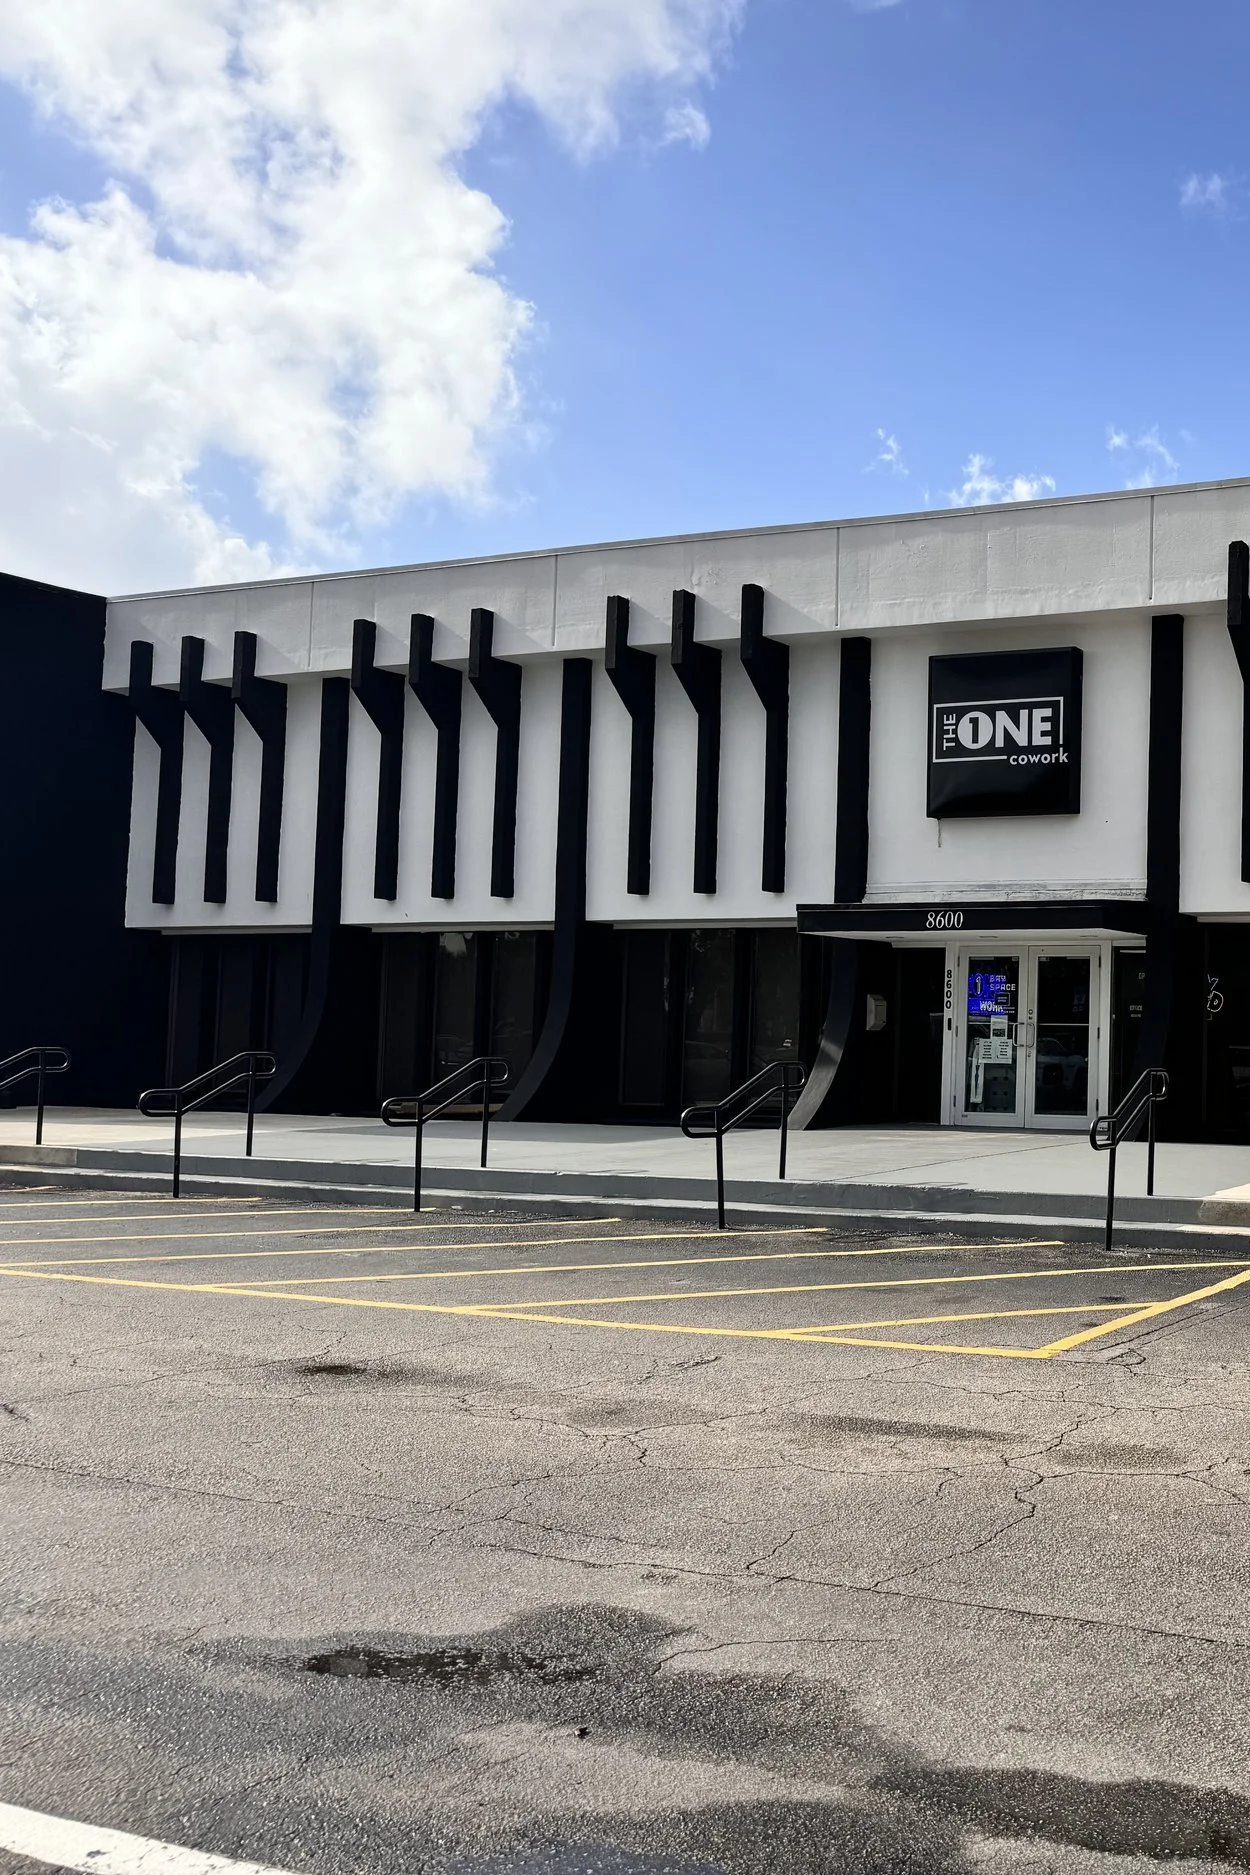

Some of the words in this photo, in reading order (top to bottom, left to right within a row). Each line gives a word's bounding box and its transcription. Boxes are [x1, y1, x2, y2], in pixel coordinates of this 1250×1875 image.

[943, 713, 956, 751] THE
[957, 708, 1053, 750] ONE
[1009, 747, 1069, 765] cowork
[925, 911, 964, 929] 8600
[945, 969, 953, 1010] 8600
